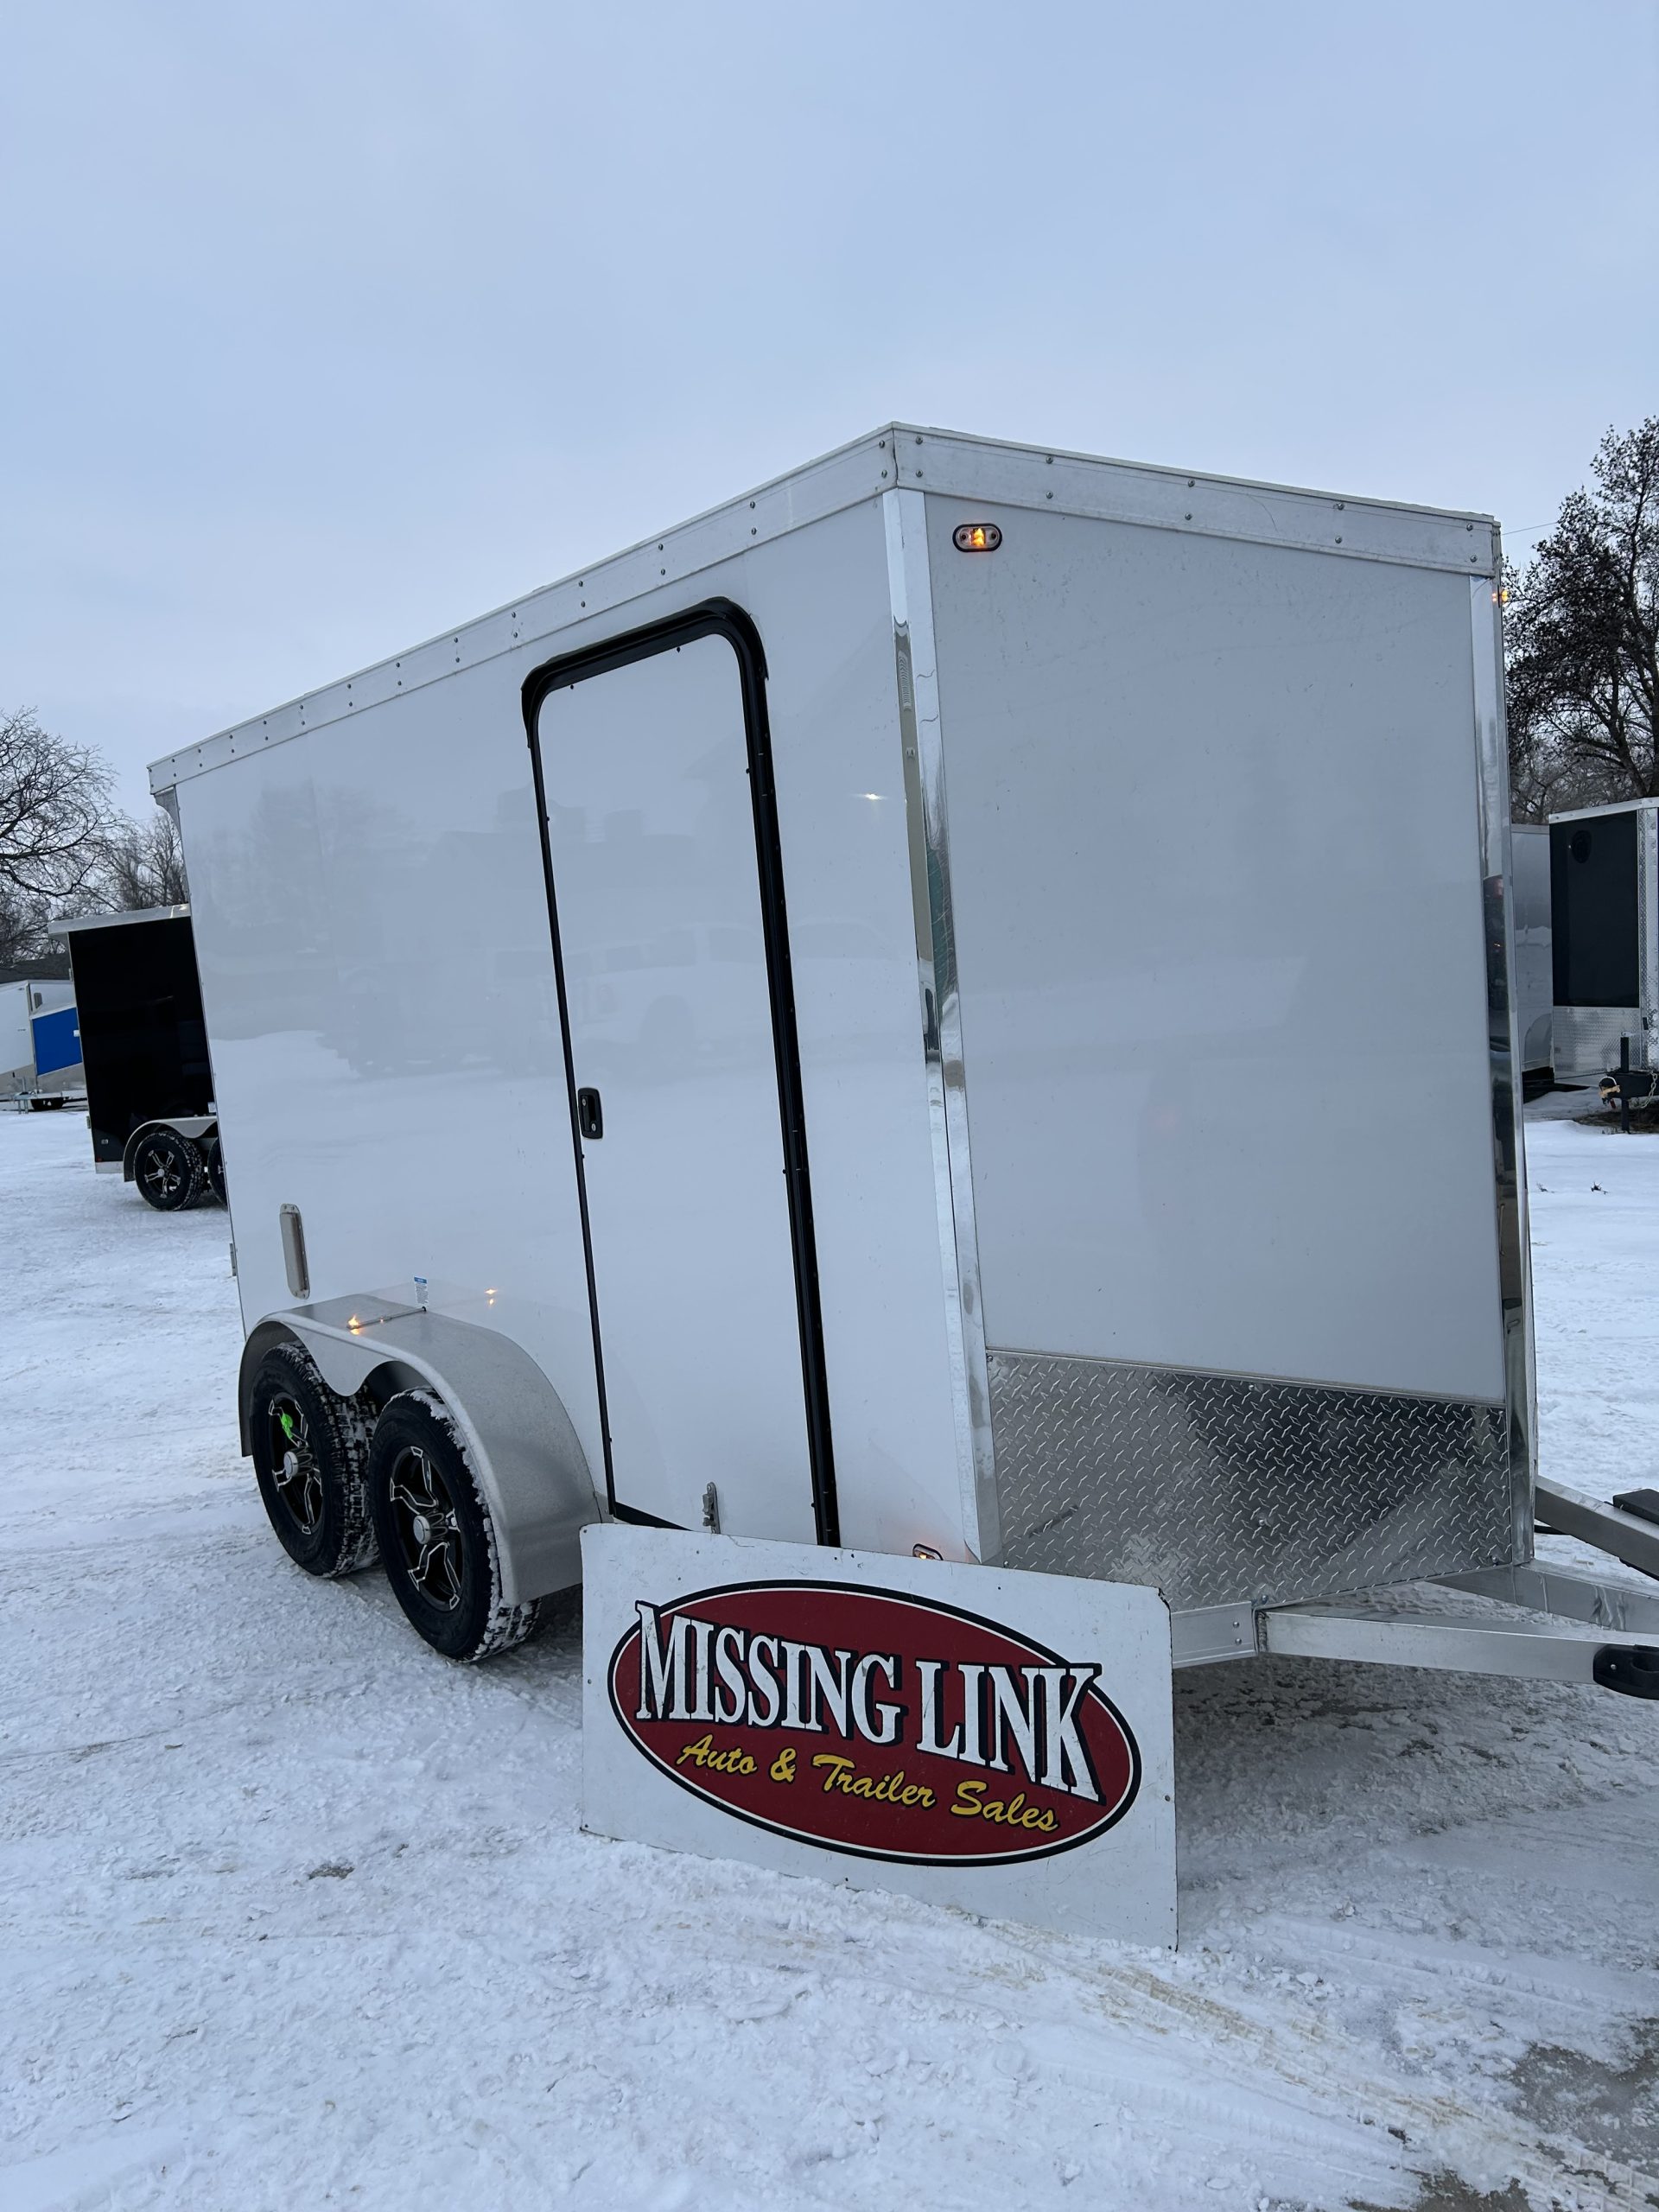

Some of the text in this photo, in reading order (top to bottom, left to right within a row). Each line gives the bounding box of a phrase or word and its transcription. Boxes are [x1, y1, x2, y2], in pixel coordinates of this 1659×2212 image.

[635, 1601, 1103, 1803] MISSING LINK
[677, 1733, 1058, 1834] Auto & Trailer Sales
